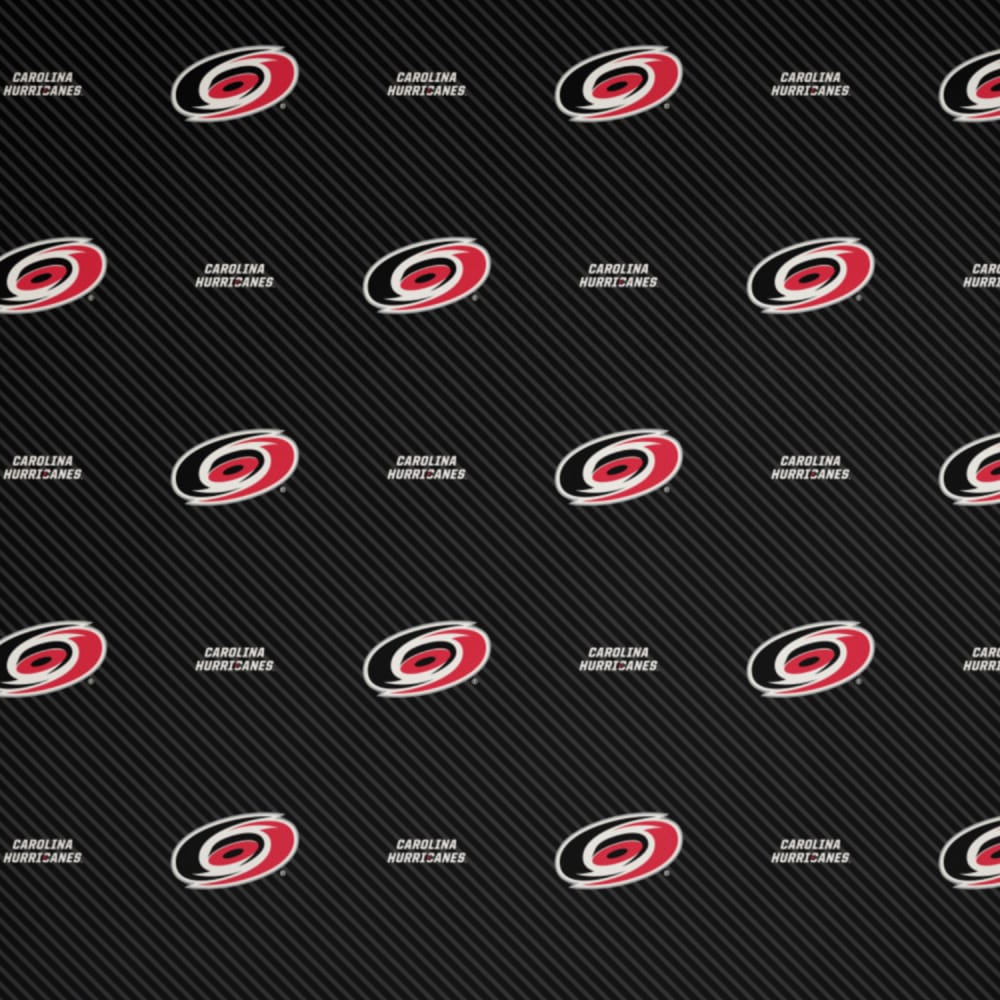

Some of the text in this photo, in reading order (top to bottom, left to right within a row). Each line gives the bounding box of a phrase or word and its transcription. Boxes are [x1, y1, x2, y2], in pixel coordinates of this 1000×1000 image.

[12, 71, 73, 83] CAROLINA
[396, 71, 457, 83] CAROLINA
[779, 71, 840, 83] CAROLINA
[3, 84, 83, 97] HURRICANES
[387, 84, 467, 97] HURRICANES
[770, 84, 850, 97] HURRICANES
[204, 263, 265, 275] CAROLINA
[587, 263, 648, 275] CAROLINA
[195, 276, 275, 289] HURRICANES
[578, 276, 658, 289] HURRICANES
[962, 276, 1000, 289] HURRI
[12, 455, 73, 467] CAROLINA
[396, 455, 457, 467] CAROLINA
[779, 455, 840, 467] CAROLINA
[3, 468, 83, 481] HURRICANES
[387, 468, 467, 481] HURRICANES
[770, 468, 850, 481] HURRICANES
[204, 646, 265, 658] CAROLINA
[587, 646, 648, 658] CAROLINA
[195, 659, 275, 672] HURRICANES
[578, 659, 658, 672] HURRICANES
[962, 659, 1000, 672] HURRI
[12, 838, 73, 850] CAROLINA
[396, 838, 457, 850] CAROLINA
[779, 838, 840, 850] CAROLINA
[3, 851, 83, 864] HURRICANES
[387, 851, 467, 864] HURRICANES
[770, 851, 850, 864] HURRICANES
